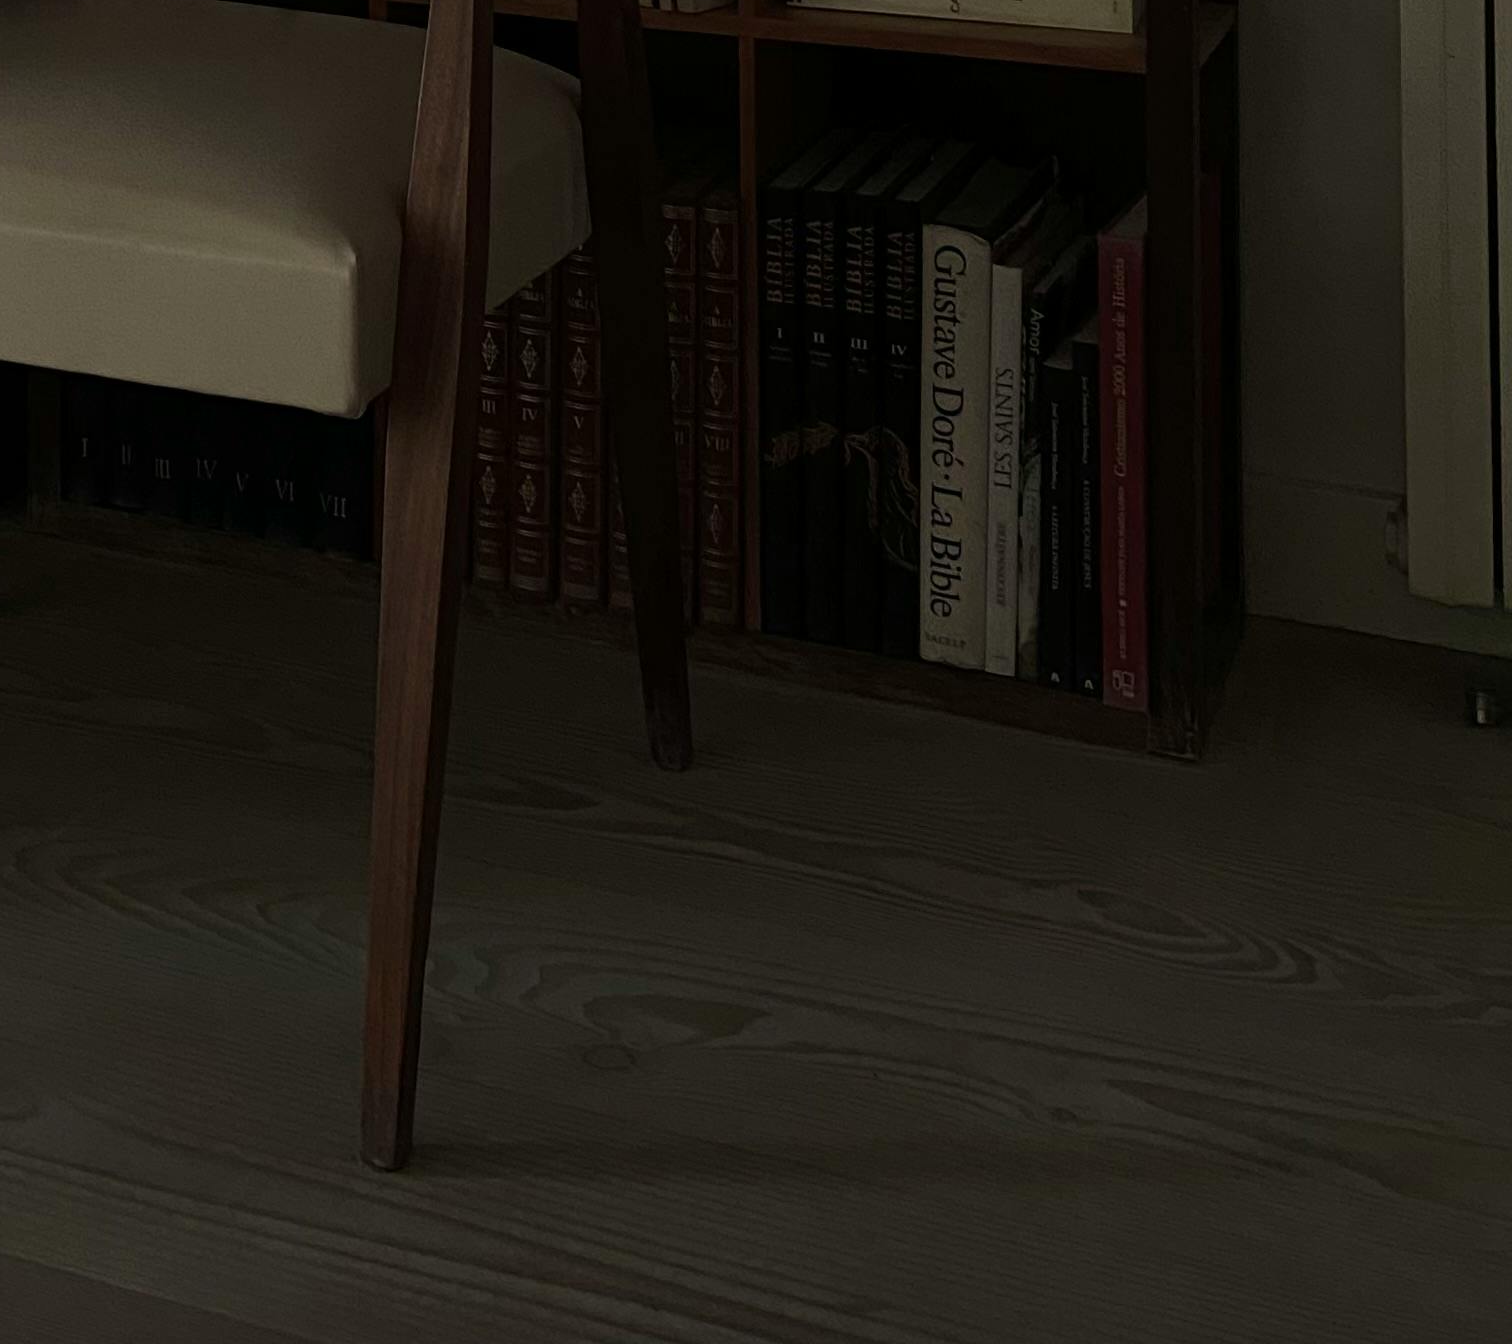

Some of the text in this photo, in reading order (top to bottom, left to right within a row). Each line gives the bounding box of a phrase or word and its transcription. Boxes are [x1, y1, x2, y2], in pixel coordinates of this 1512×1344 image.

[1111, 257, 1126, 308] História
[934, 245, 967, 379] Gustave
[1112, 312, 1126, 328] de
[777, 327, 783, 339] I
[813, 332, 825, 344] II
[850, 337, 868, 350] III
[1029, 309, 1044, 355] Amor
[891, 344, 908, 355] IV
[1113, 332, 1126, 363] Anos
[1112, 365, 1126, 396] 2000
[931, 383, 965, 467] Doré
[993, 367, 1014, 489] LES SAINTS
[1113, 399, 1126, 476] Cristianismo
[81, 437, 88, 458] I
[121, 442, 133, 465] II
[154, 457, 172, 480] III
[195, 458, 218, 480] IV
[236, 472, 250, 493] V
[275, 478, 295, 502] VI
[320, 492, 348, 520] VII
[931, 482, 963, 527] La
[931, 535, 963, 617] Bible
